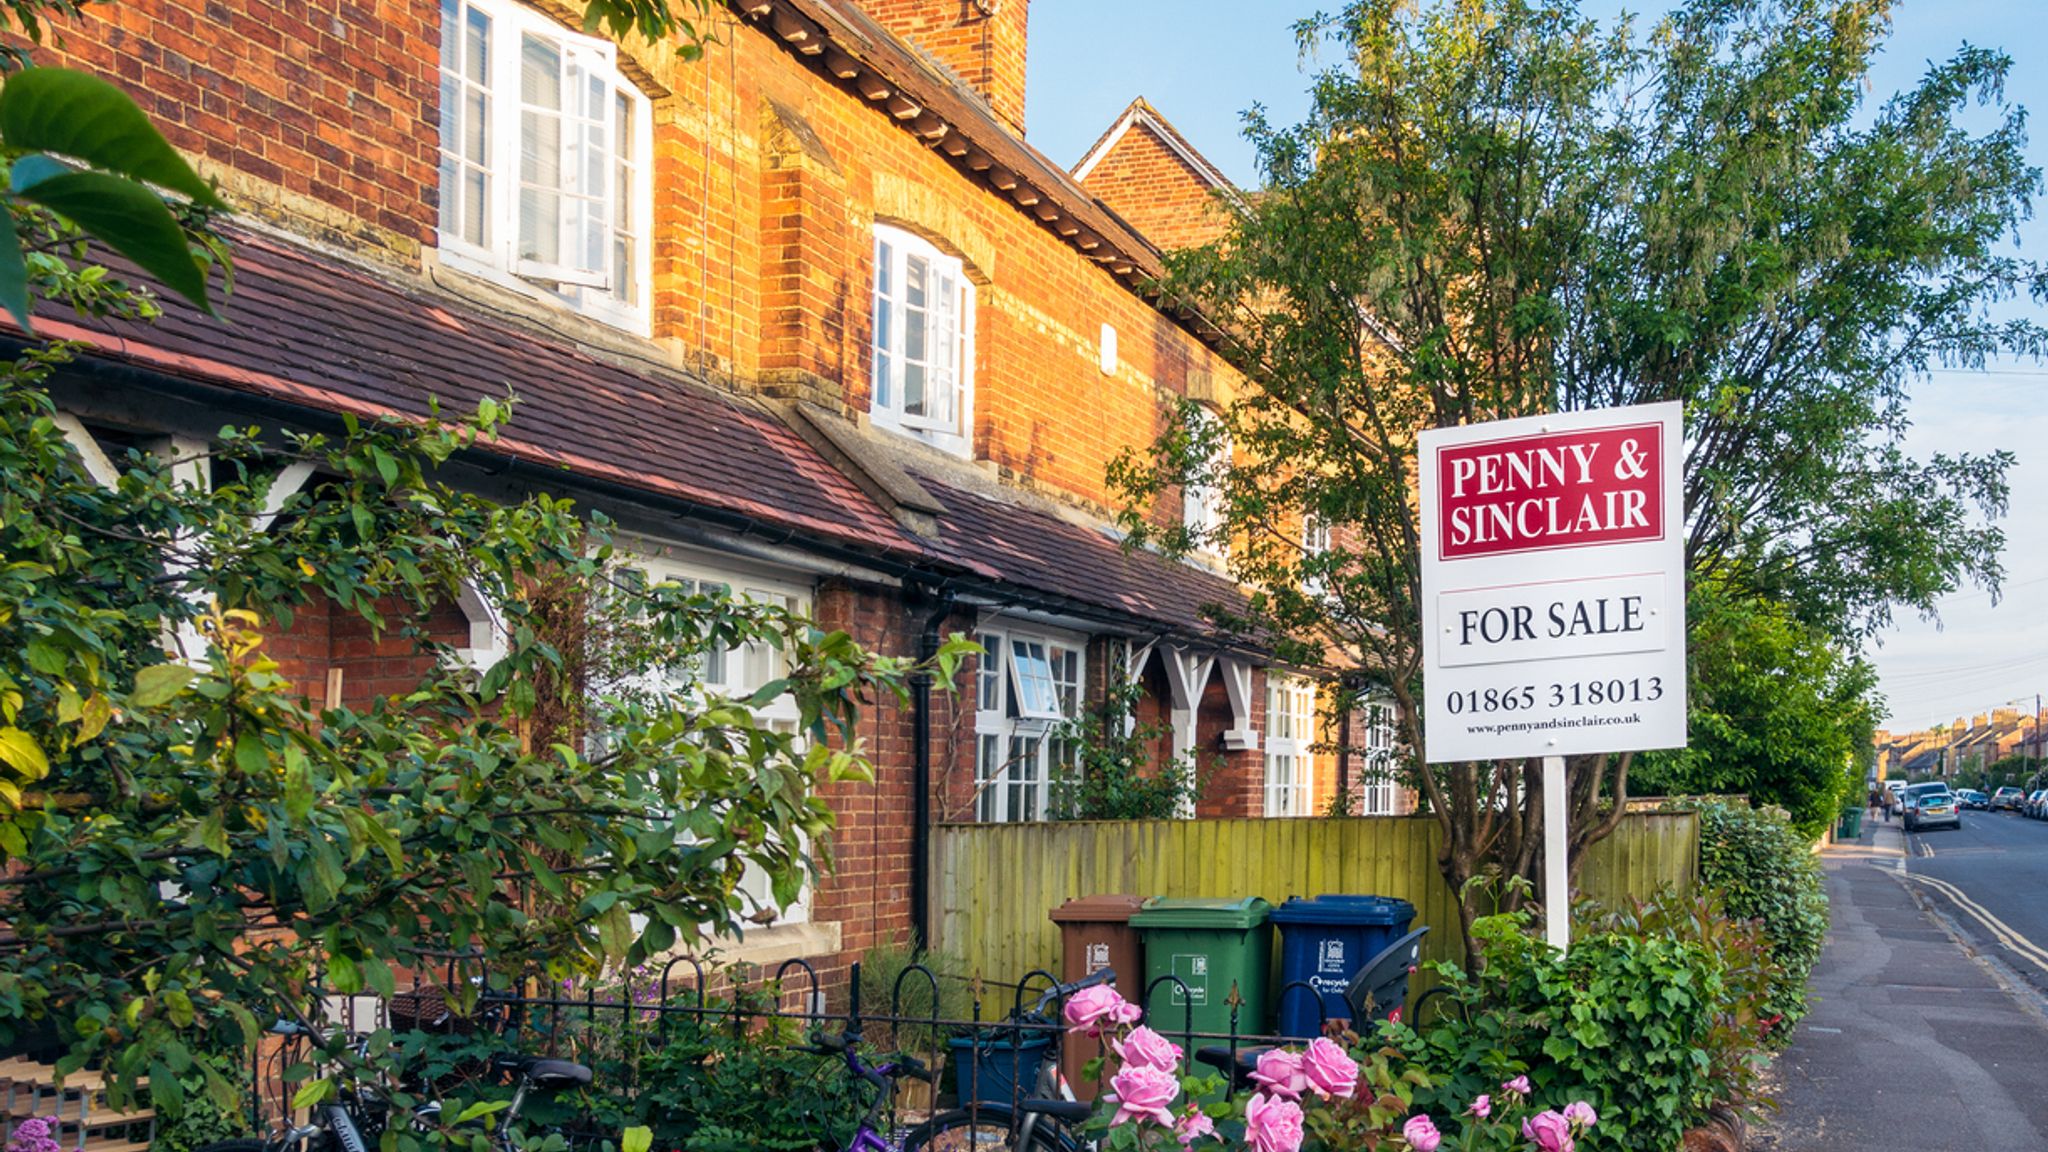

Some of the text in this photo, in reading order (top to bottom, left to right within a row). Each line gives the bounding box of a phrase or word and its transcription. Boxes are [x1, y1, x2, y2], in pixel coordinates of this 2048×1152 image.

[1451, 438, 1648, 498] PENNY &
[1451, 489, 1650, 546] SINCLAIR
[1459, 595, 1644, 646] FOR SALE
[1447, 676, 1663, 714] 01865 318013
[1467, 712, 1641, 735] www.pennyandsinclair.co.uk
